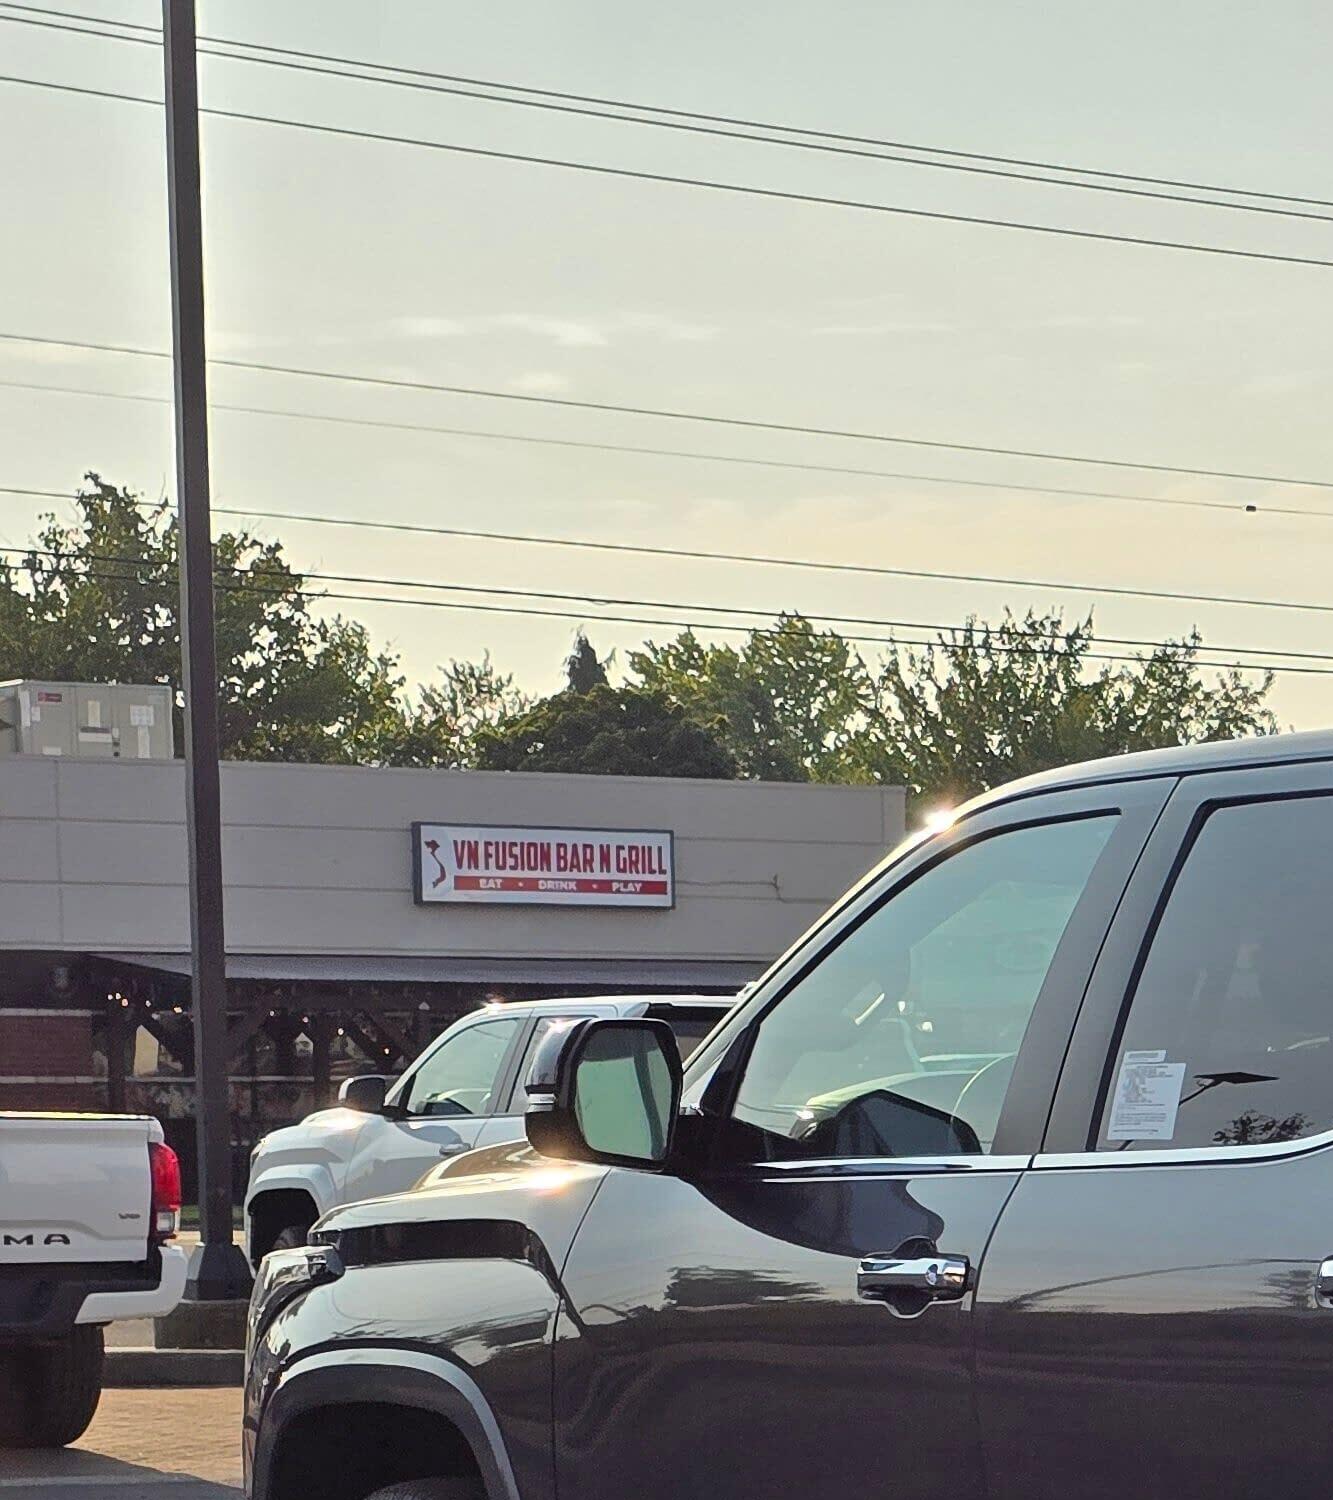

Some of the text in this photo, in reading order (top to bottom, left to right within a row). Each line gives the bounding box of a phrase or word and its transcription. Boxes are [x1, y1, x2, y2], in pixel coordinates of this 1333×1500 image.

[453, 840, 667, 875] VN FUSION BAR N GRILL
[479, 878, 642, 892] EAT DRINK PLAY
